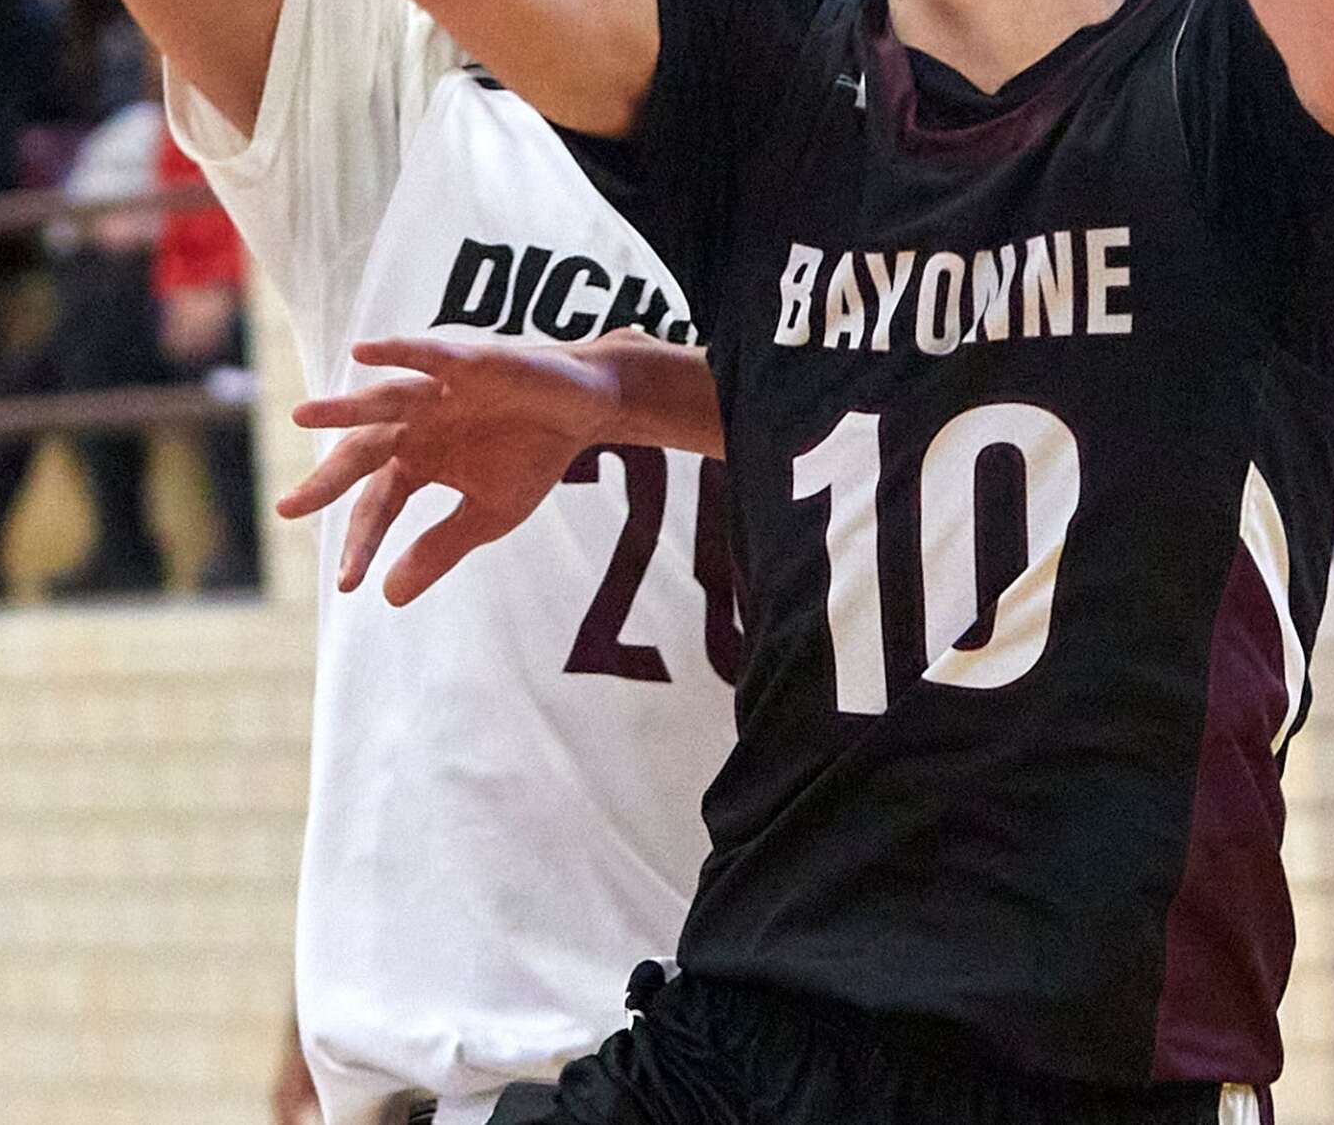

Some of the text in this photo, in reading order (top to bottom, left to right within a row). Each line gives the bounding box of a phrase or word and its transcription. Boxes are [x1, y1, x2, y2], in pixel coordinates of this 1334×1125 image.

[428, 237, 690, 343] DICK
[774, 227, 1132, 355] BAYONNE
[792, 402, 1081, 715] 10
